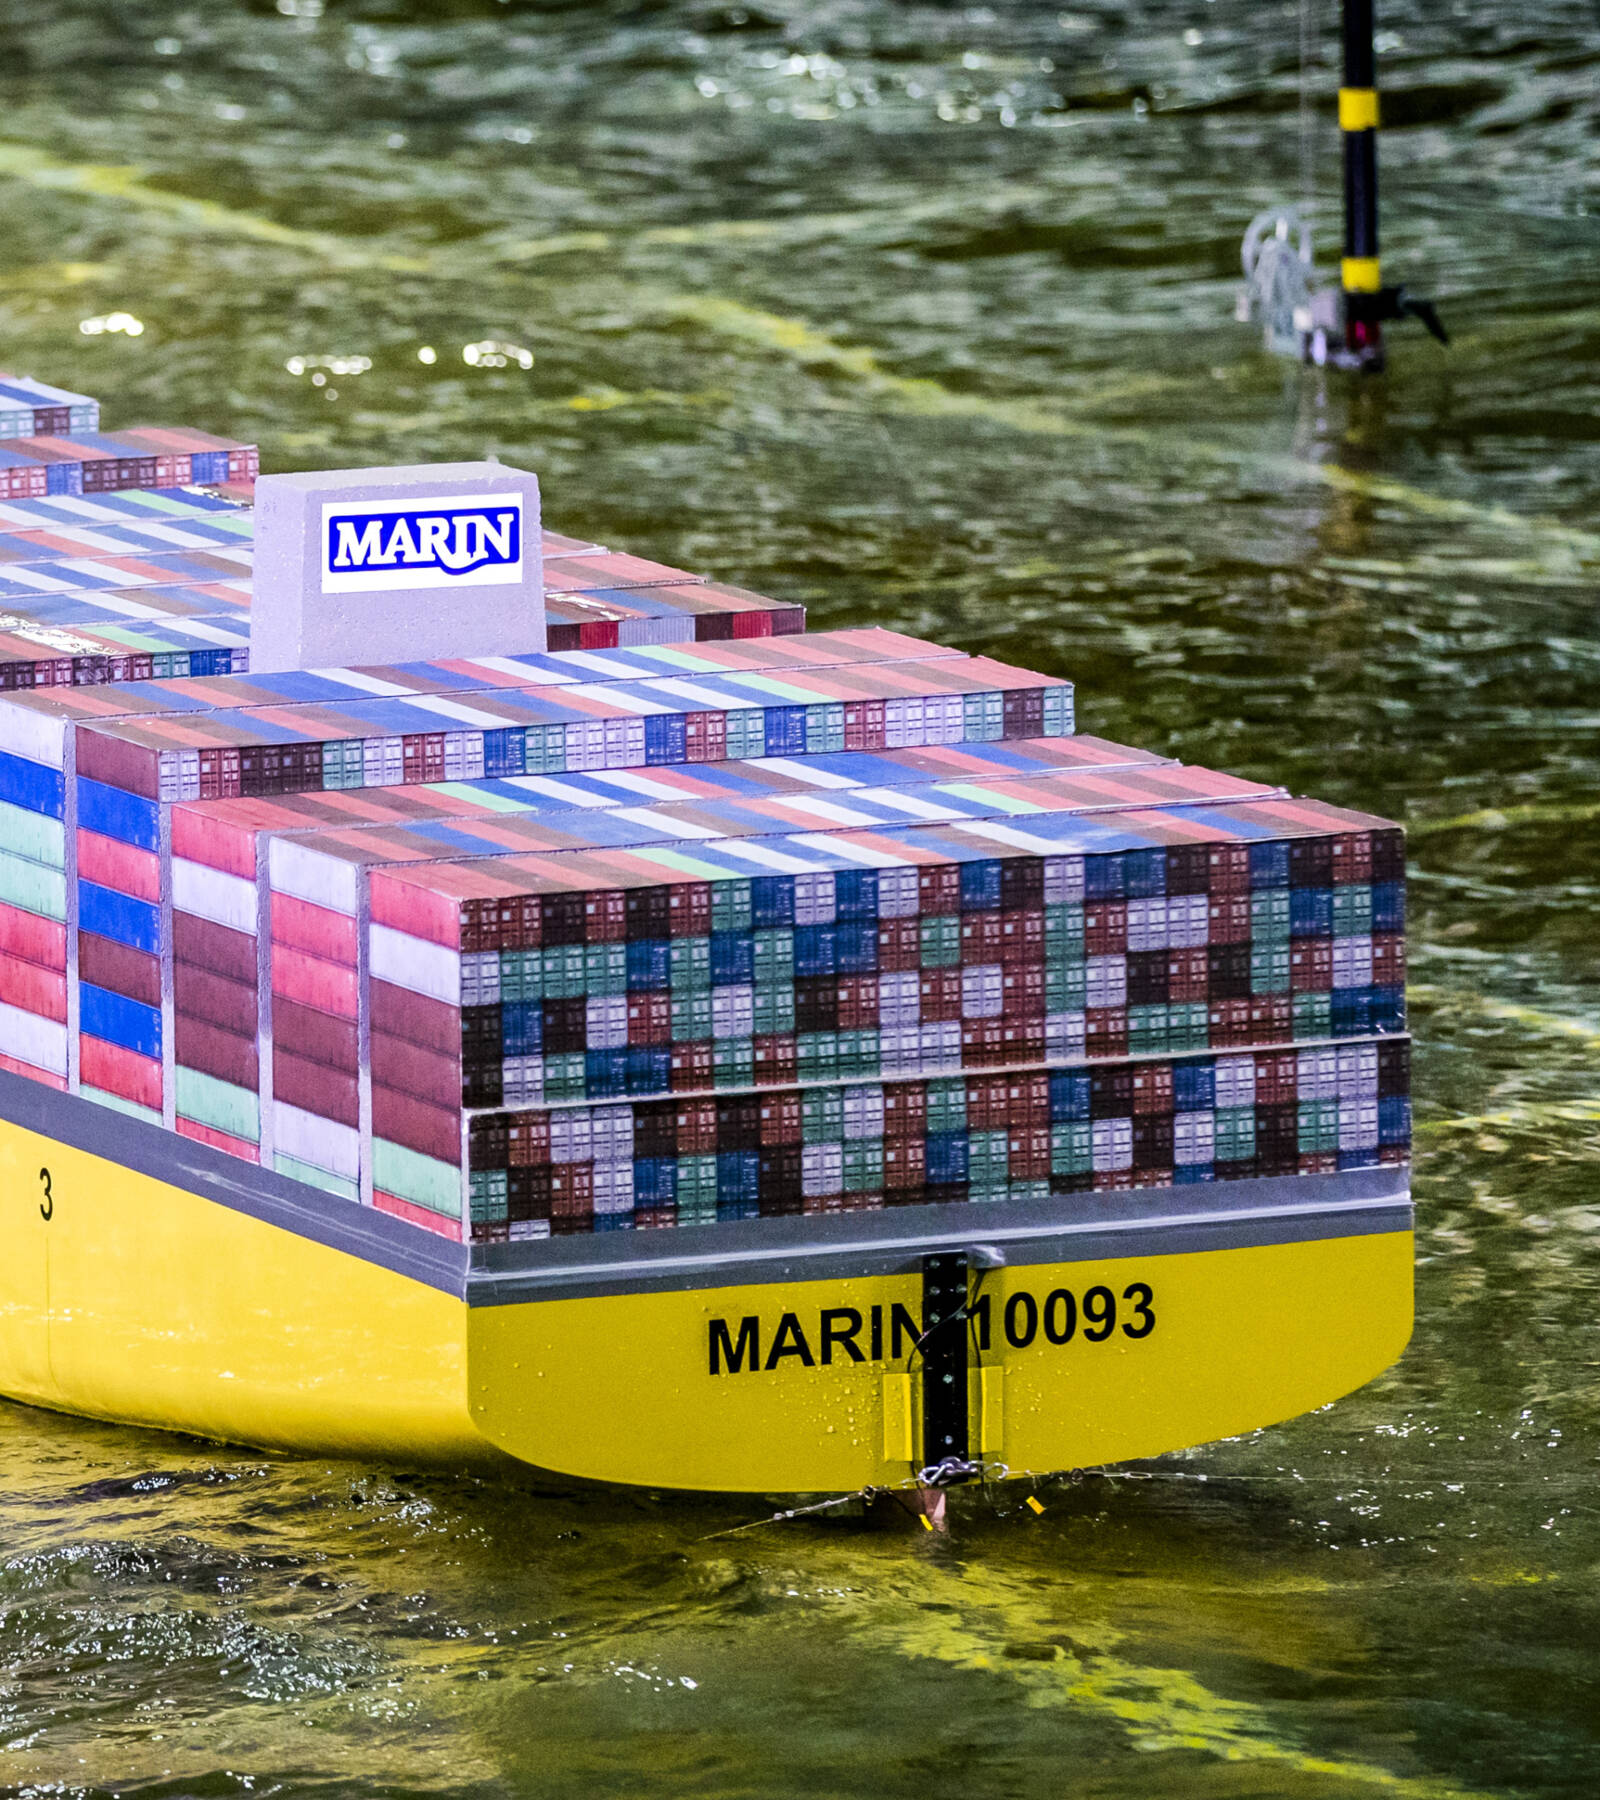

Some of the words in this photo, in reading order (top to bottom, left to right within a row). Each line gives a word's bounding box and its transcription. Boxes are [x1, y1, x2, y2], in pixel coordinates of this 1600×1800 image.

[333, 512, 516, 570] MARIN
[39, 1167, 53, 1222] 3
[708, 1302, 926, 1376] MARIN
[965, 1281, 1157, 1351] 10093
